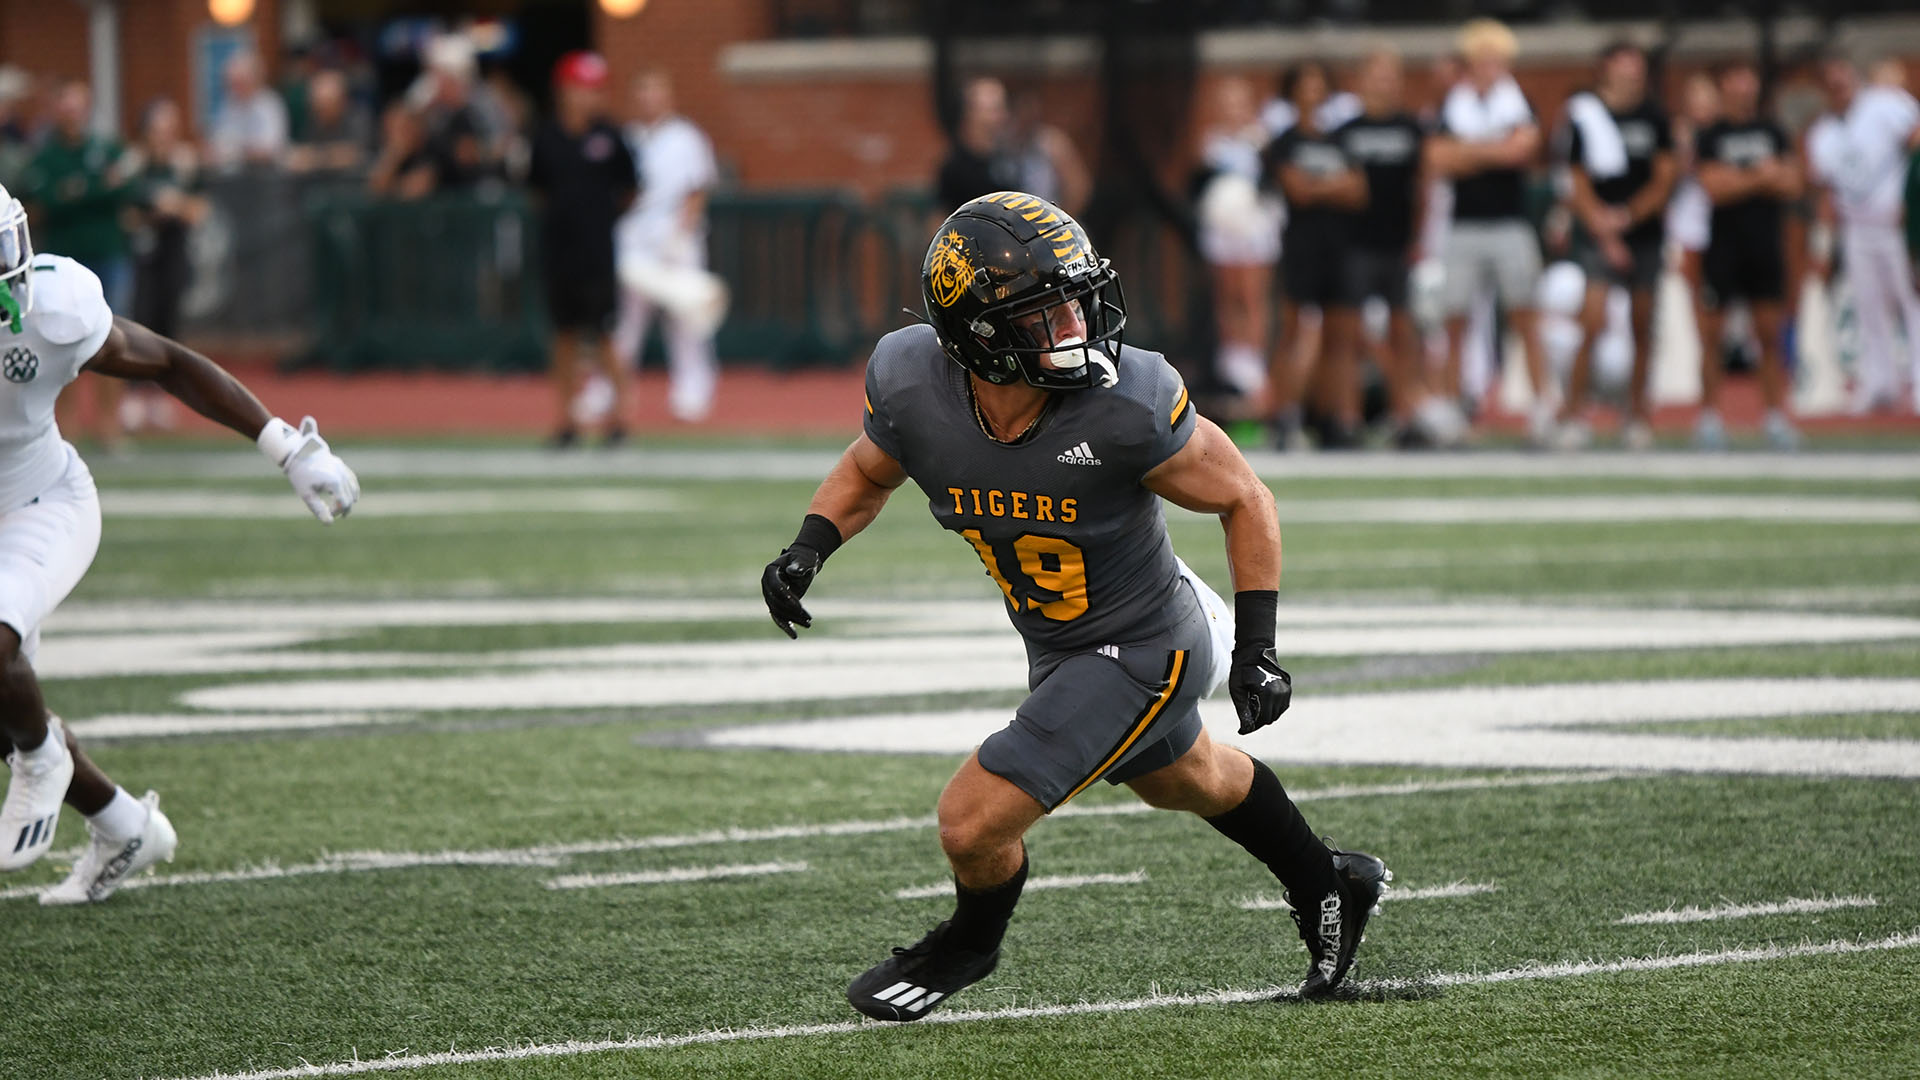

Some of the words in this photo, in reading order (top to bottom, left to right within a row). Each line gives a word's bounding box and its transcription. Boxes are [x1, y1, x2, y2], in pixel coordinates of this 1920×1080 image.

[1066, 256, 1088, 274] FHSU
[1057, 454, 1102, 466] adidas
[947, 487, 1077, 523] TIGERS
[960, 529, 1089, 621] 19
